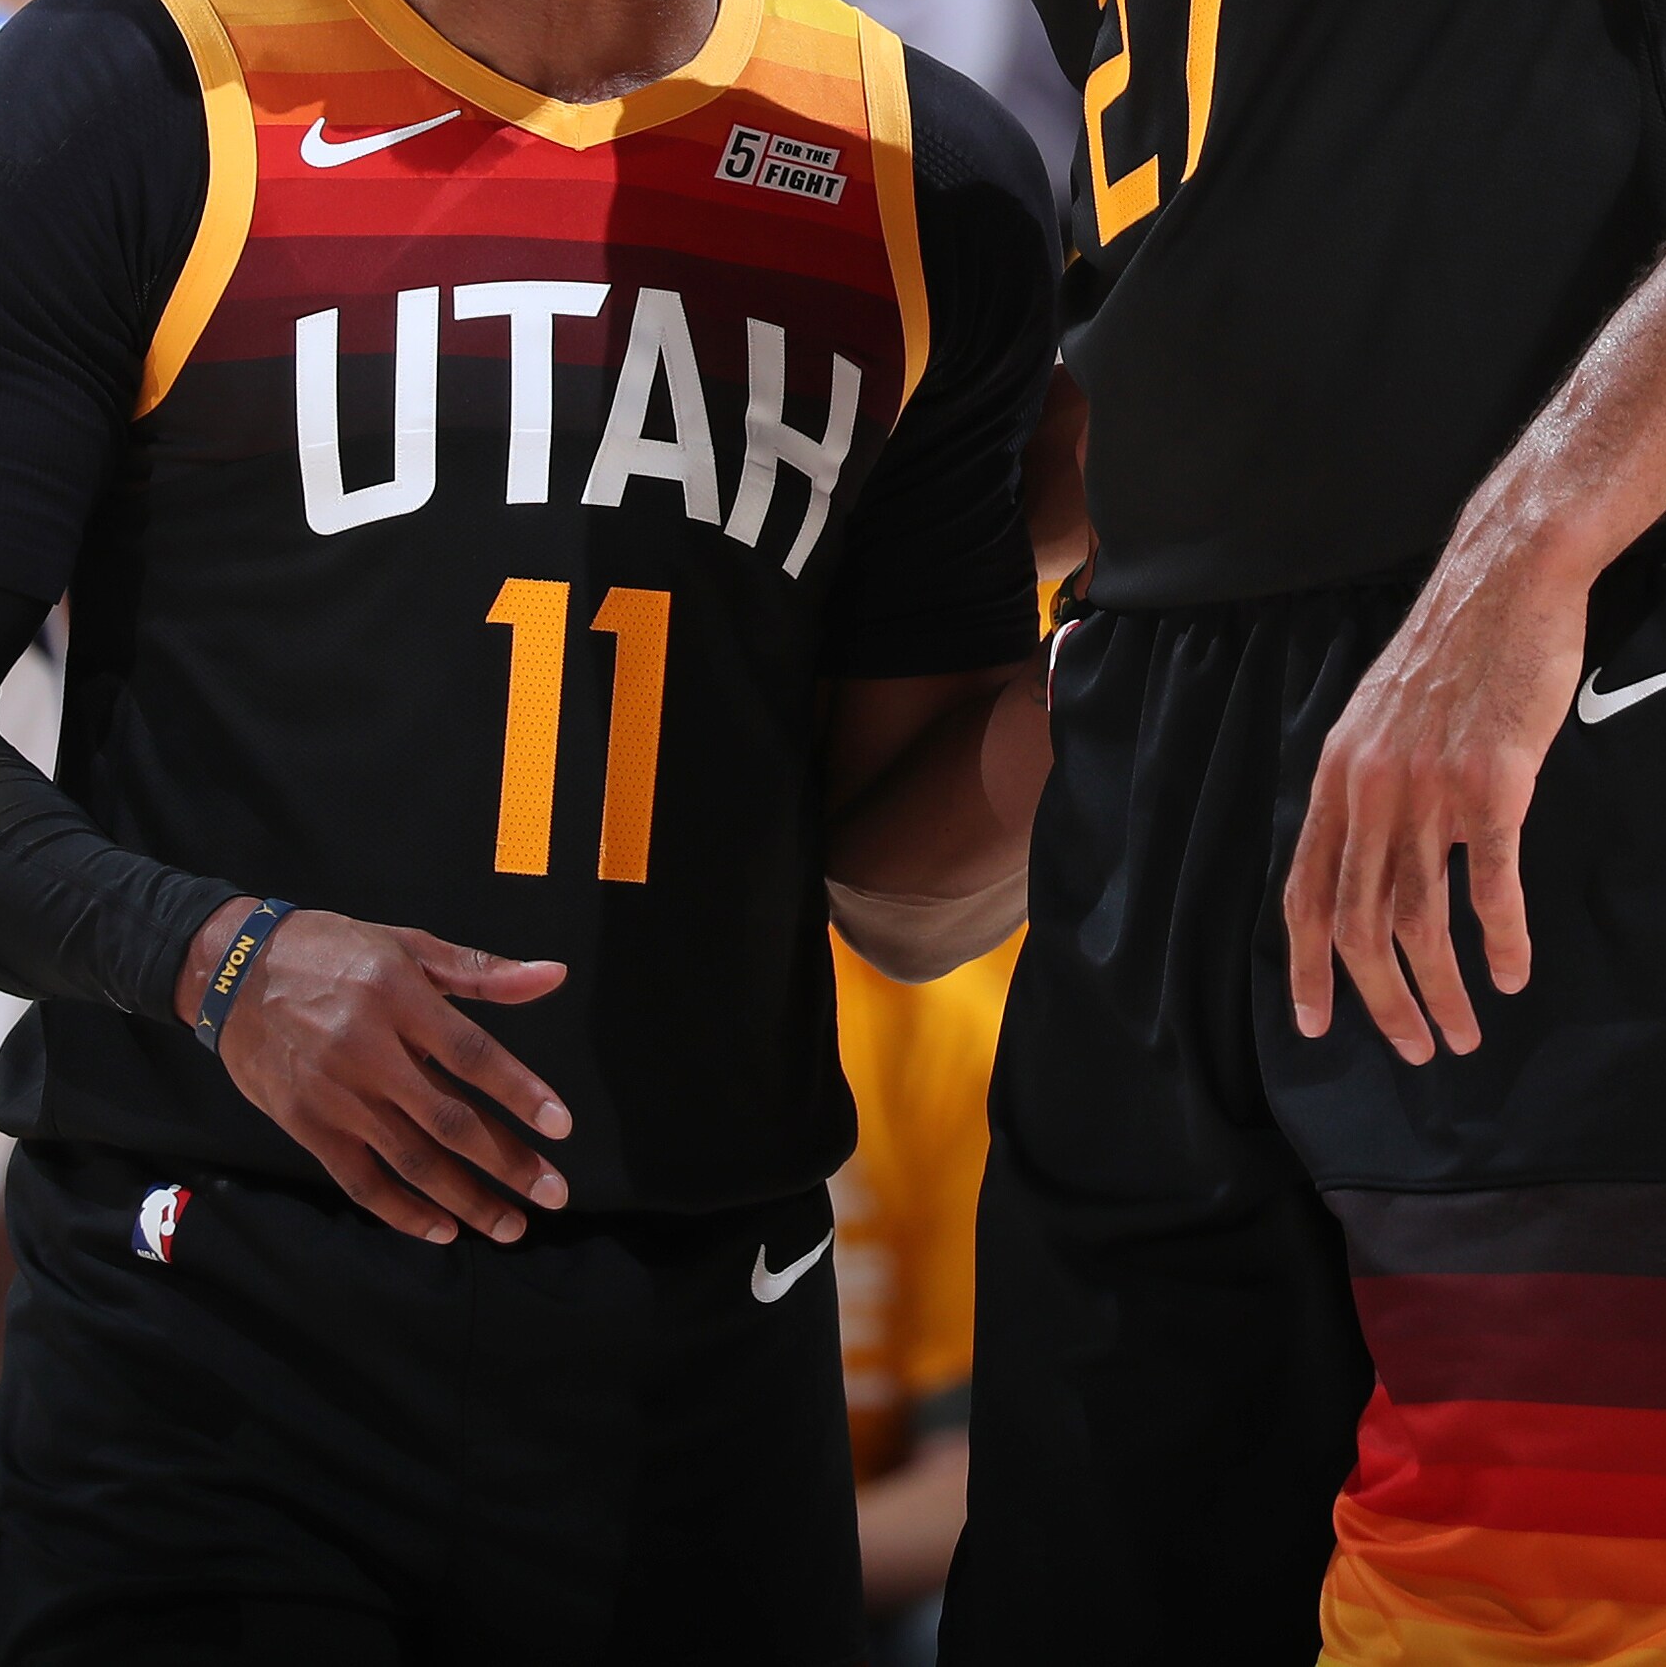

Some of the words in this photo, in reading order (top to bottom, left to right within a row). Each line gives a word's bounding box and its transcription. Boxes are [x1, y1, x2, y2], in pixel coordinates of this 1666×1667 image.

[725, 130, 761, 178] 5
[775, 140, 803, 158] FOR
[805, 147, 832, 165] THE
[764, 163, 840, 198] FIGHT
[295, 280, 862, 579] UTAH
[485, 577, 671, 884] 11
[214, 935, 256, 995] NOAH
